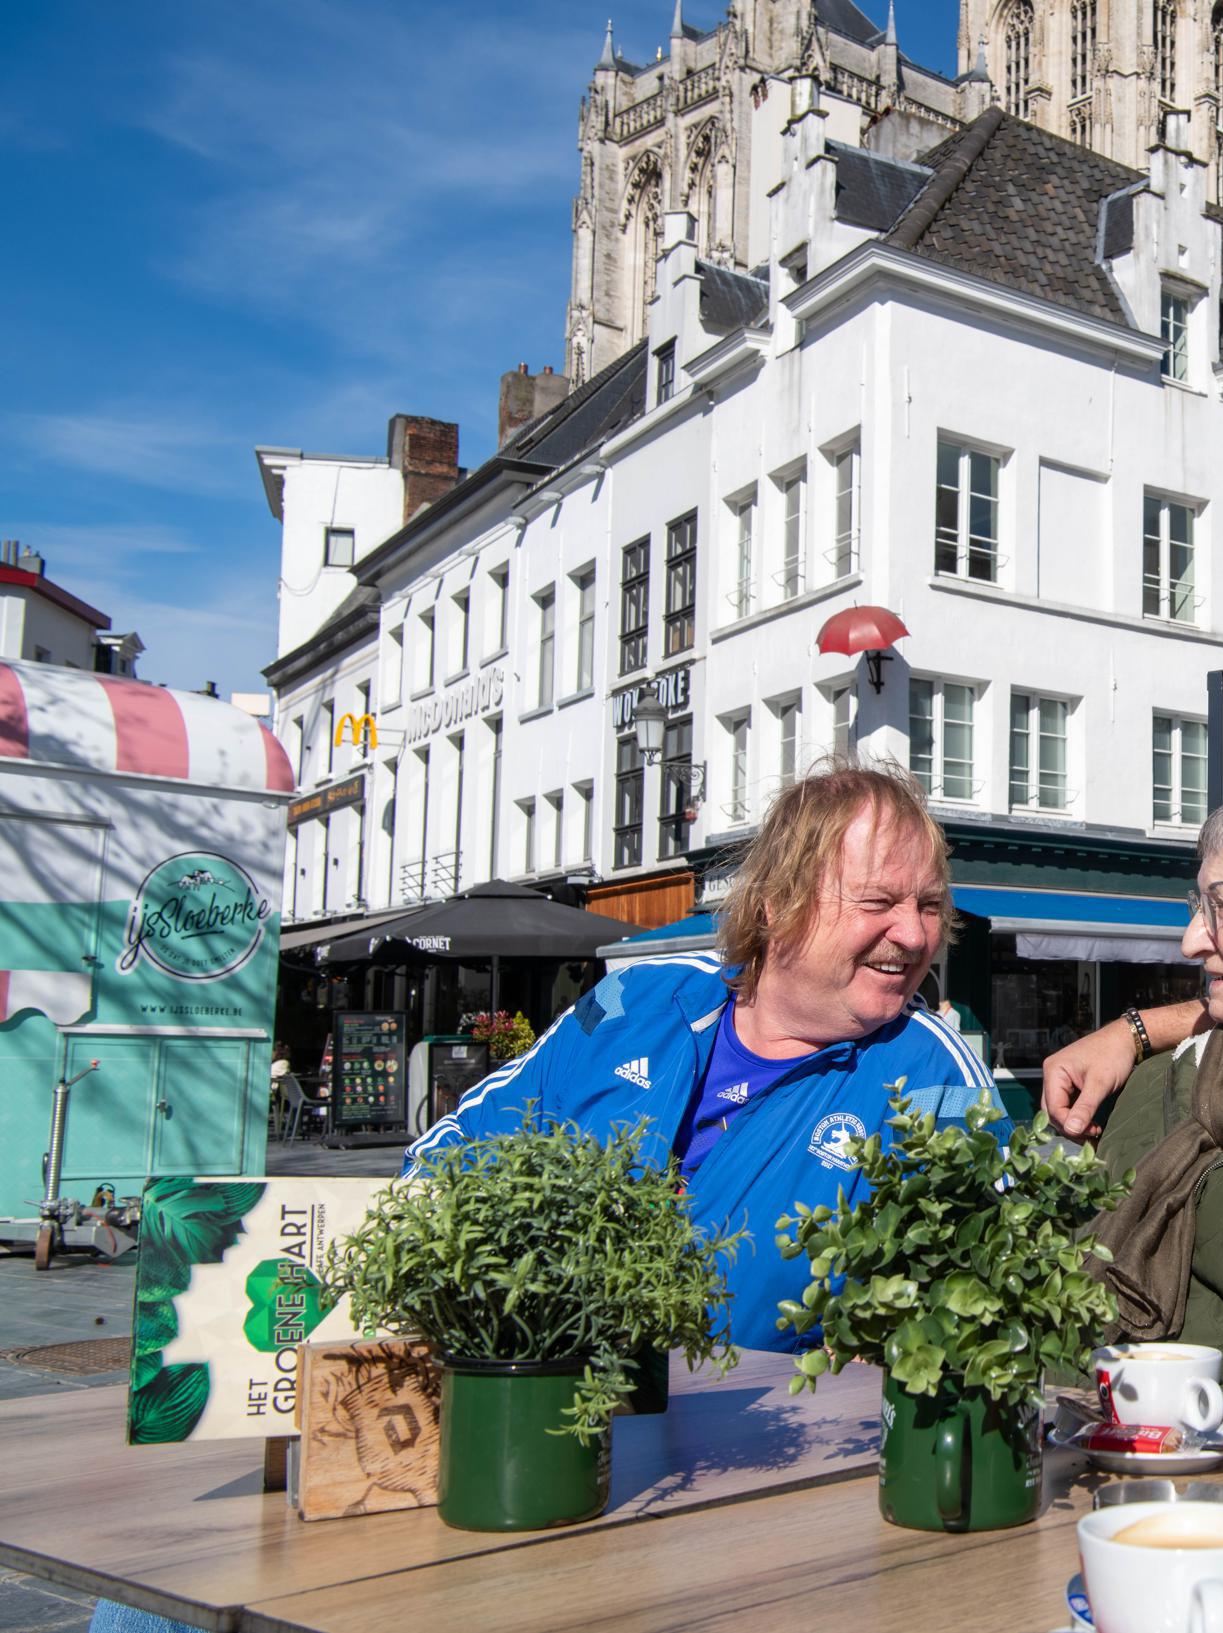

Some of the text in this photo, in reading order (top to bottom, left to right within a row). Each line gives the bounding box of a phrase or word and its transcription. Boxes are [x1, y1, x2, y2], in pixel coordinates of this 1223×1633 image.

[407, 667, 504, 743] McDonald's
[413, 937, 451, 951] CORNET
[614, 1066, 652, 1089] adidas
[316, 1203, 326, 1251] ANTWERPEN
[272, 1204, 308, 1415] GROENE HART
[247, 1378, 269, 1416] HET
